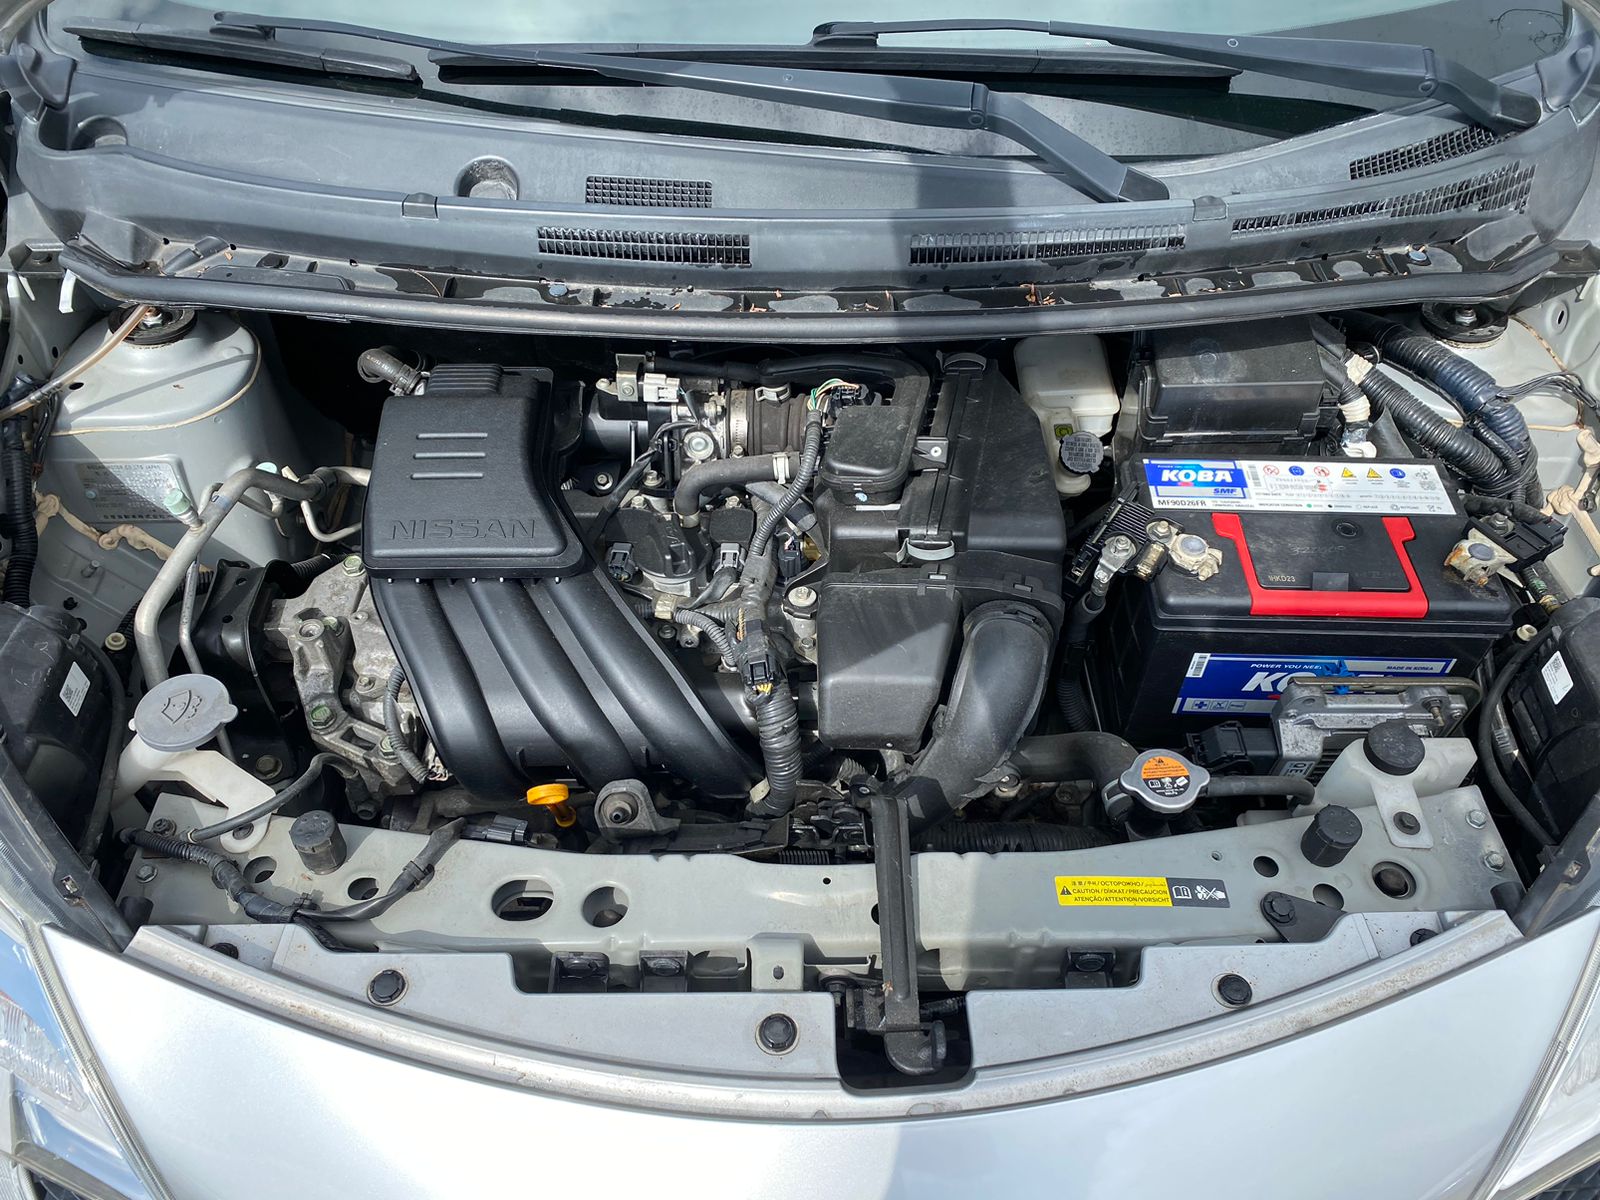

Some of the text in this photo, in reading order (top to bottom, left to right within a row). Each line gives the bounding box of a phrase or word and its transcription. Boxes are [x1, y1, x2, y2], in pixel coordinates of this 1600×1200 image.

[1161, 469, 1233, 483] KOBA
[1157, 499, 1206, 507] MF90D26FR
[391, 519, 536, 541] NISSAN
